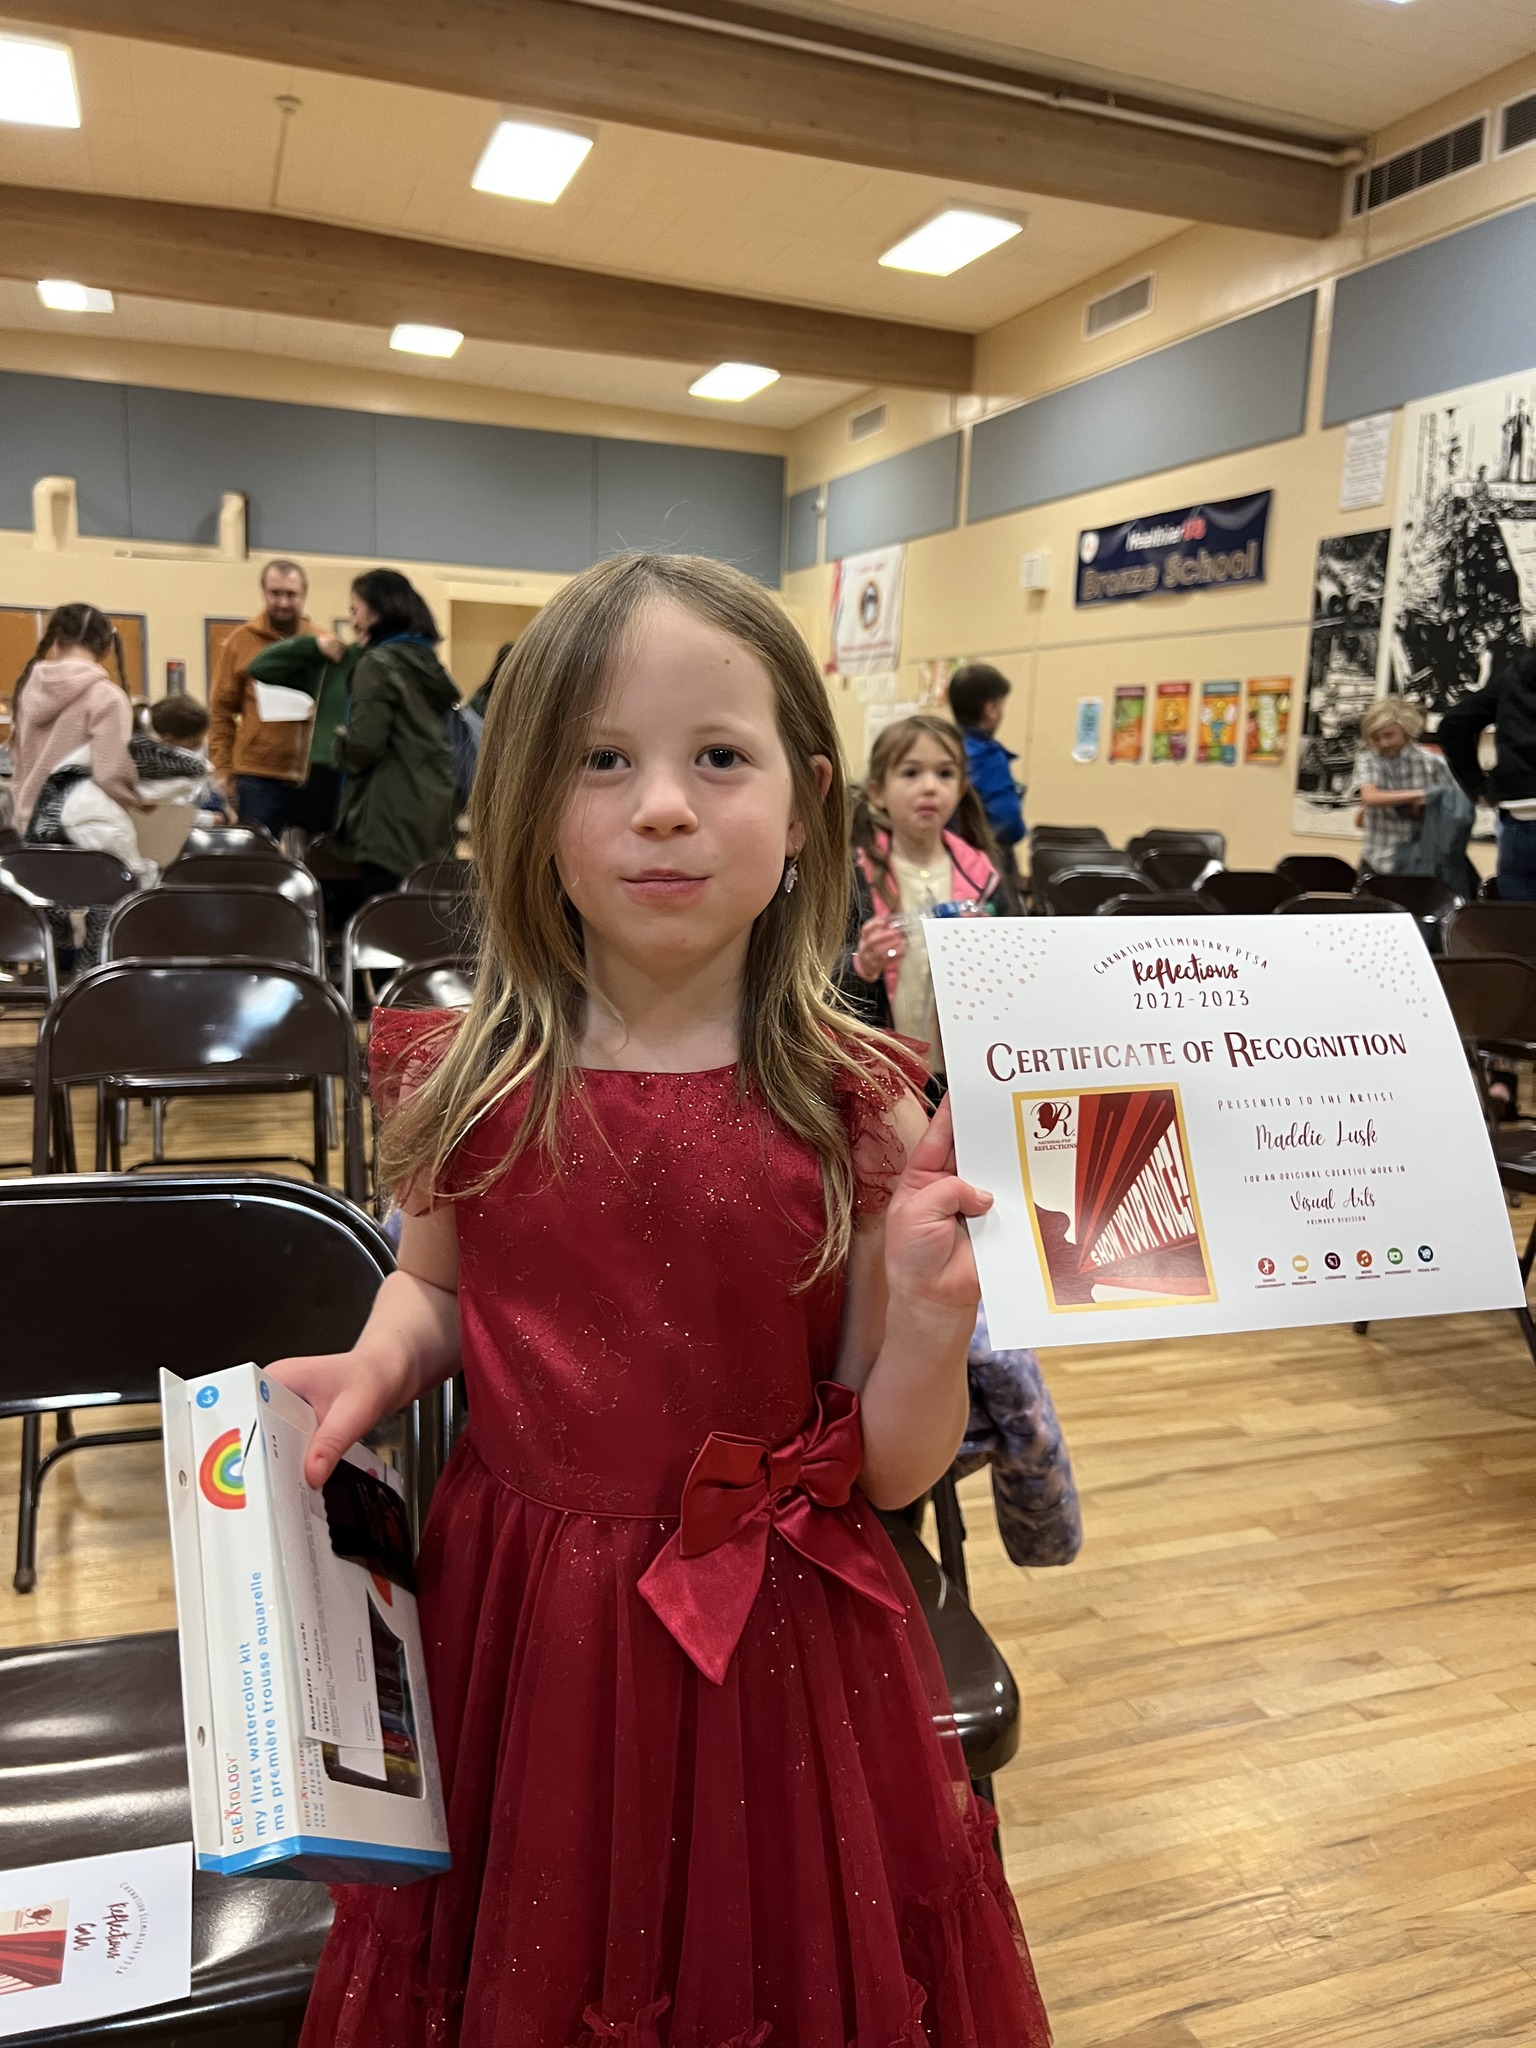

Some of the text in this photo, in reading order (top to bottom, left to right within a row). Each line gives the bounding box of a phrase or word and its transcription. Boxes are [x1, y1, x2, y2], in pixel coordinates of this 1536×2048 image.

[1080, 538, 1259, 600] Bronze School
[1093, 940, 1152, 975] CARNATION
[1154, 937, 1230, 953] ELEMENTARY
[1132, 953, 1240, 990] Reflections
[1133, 989, 1250, 1010] 2022-2023
[985, 1030, 1409, 1082] CERTIFICATE OF RECOGNITION
[1217, 1091, 1394, 1111] PRESENTED TO THE ARTIST
[1255, 1118, 1379, 1151] Maddie Lusk
[1279, 1170, 1322, 1181] ORIGINAL
[1324, 1166, 1367, 1178] CREATIVE
[1370, 1165, 1393, 1175] WORK
[1289, 1186, 1377, 1212] Visual Arts
[1090, 1219, 1126, 1267] SHOW
[250, 1571, 286, 1831] ma première trousse aquarelle
[238, 1641, 267, 1837] my first watercolor kit
[102, 1901, 132, 1960] Reflections
